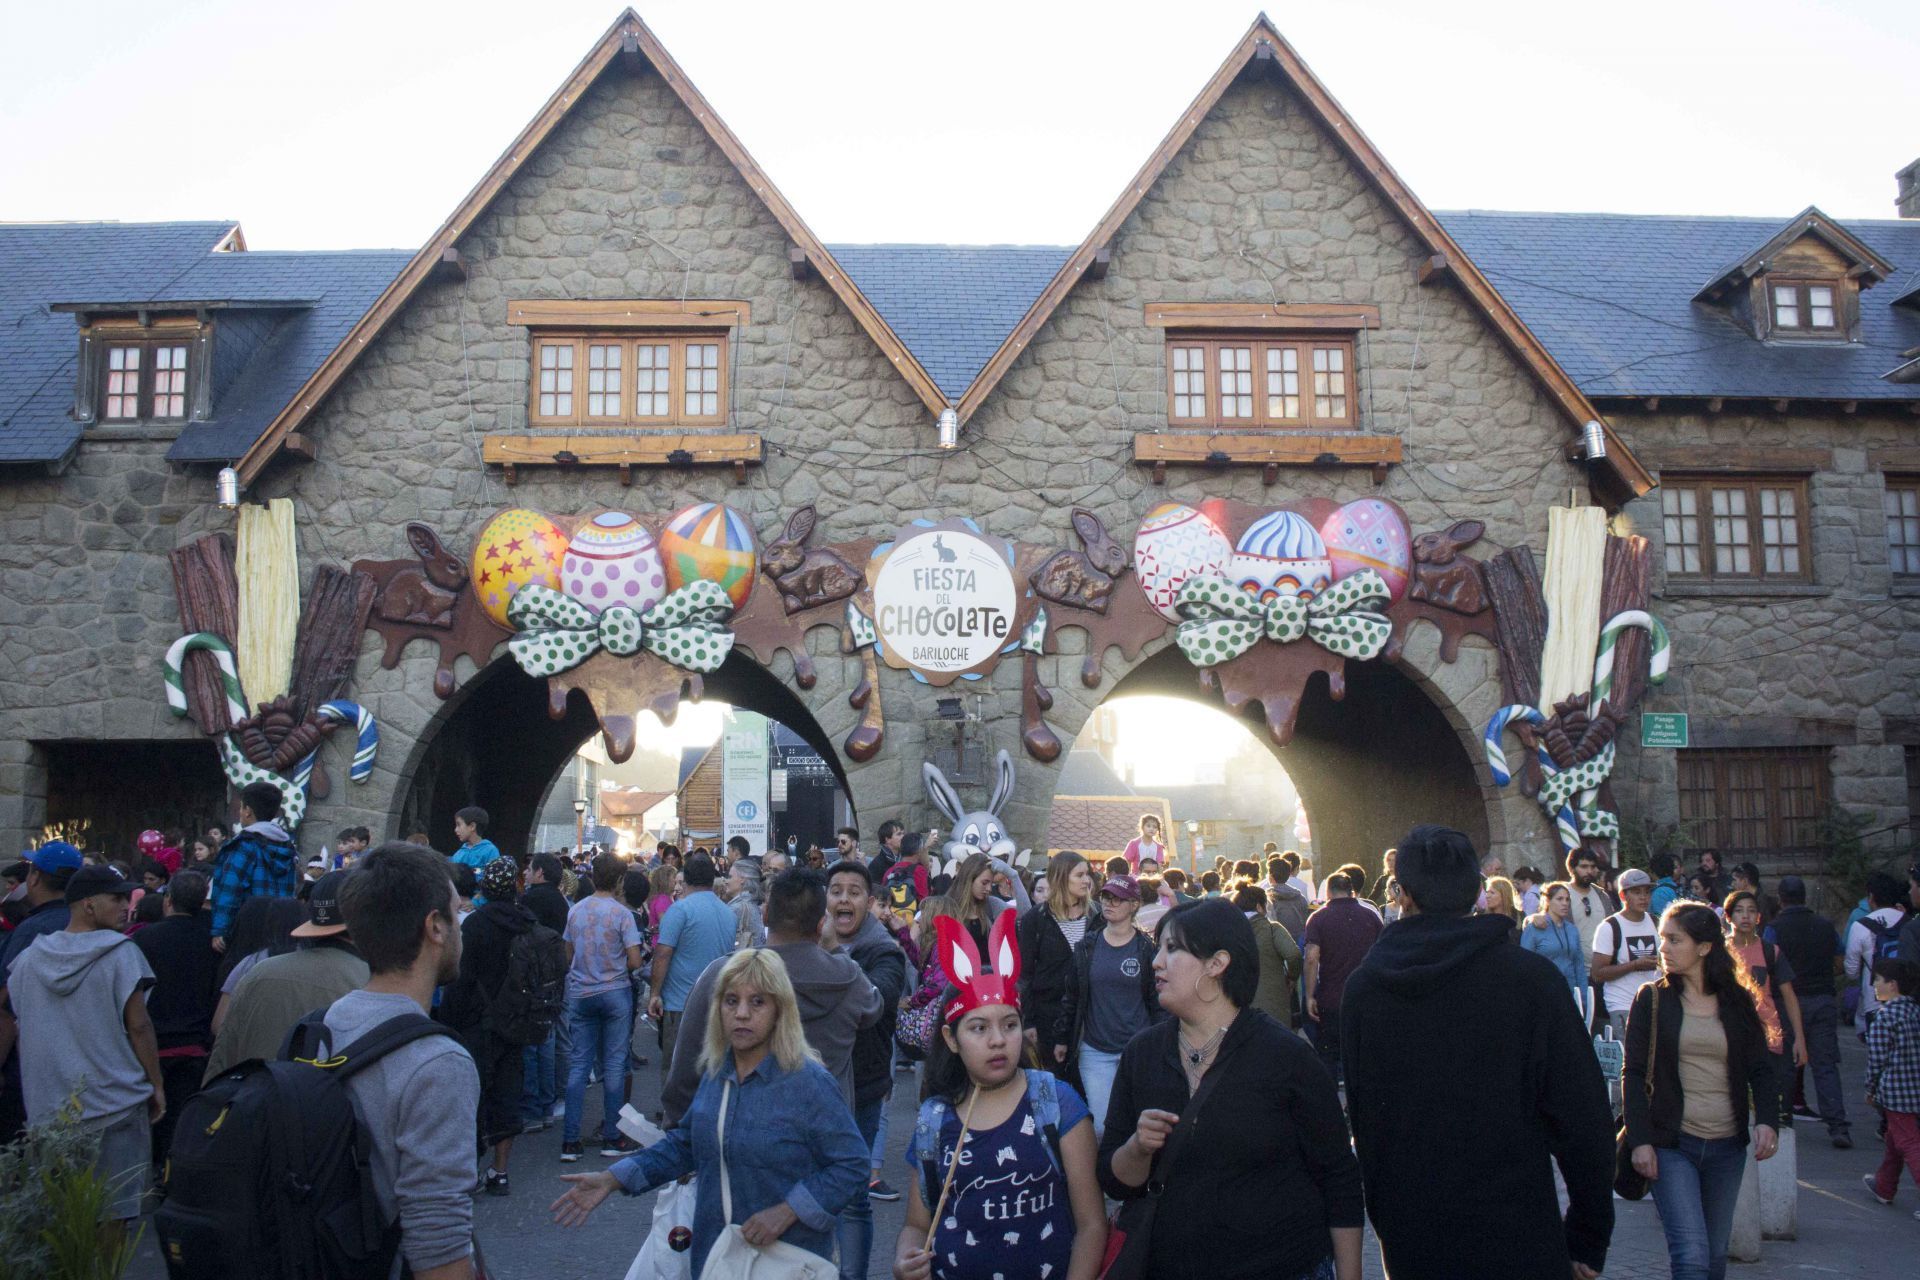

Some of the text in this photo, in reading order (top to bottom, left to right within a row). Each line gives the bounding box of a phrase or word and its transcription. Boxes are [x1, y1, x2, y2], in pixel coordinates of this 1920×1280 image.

[936, 593, 952, 605] DEL
[912, 646, 969, 661] BARILOCHE
[943, 1145, 974, 1166] be
[942, 1164, 1052, 1216] you
[982, 1182, 1054, 1221] tiful
